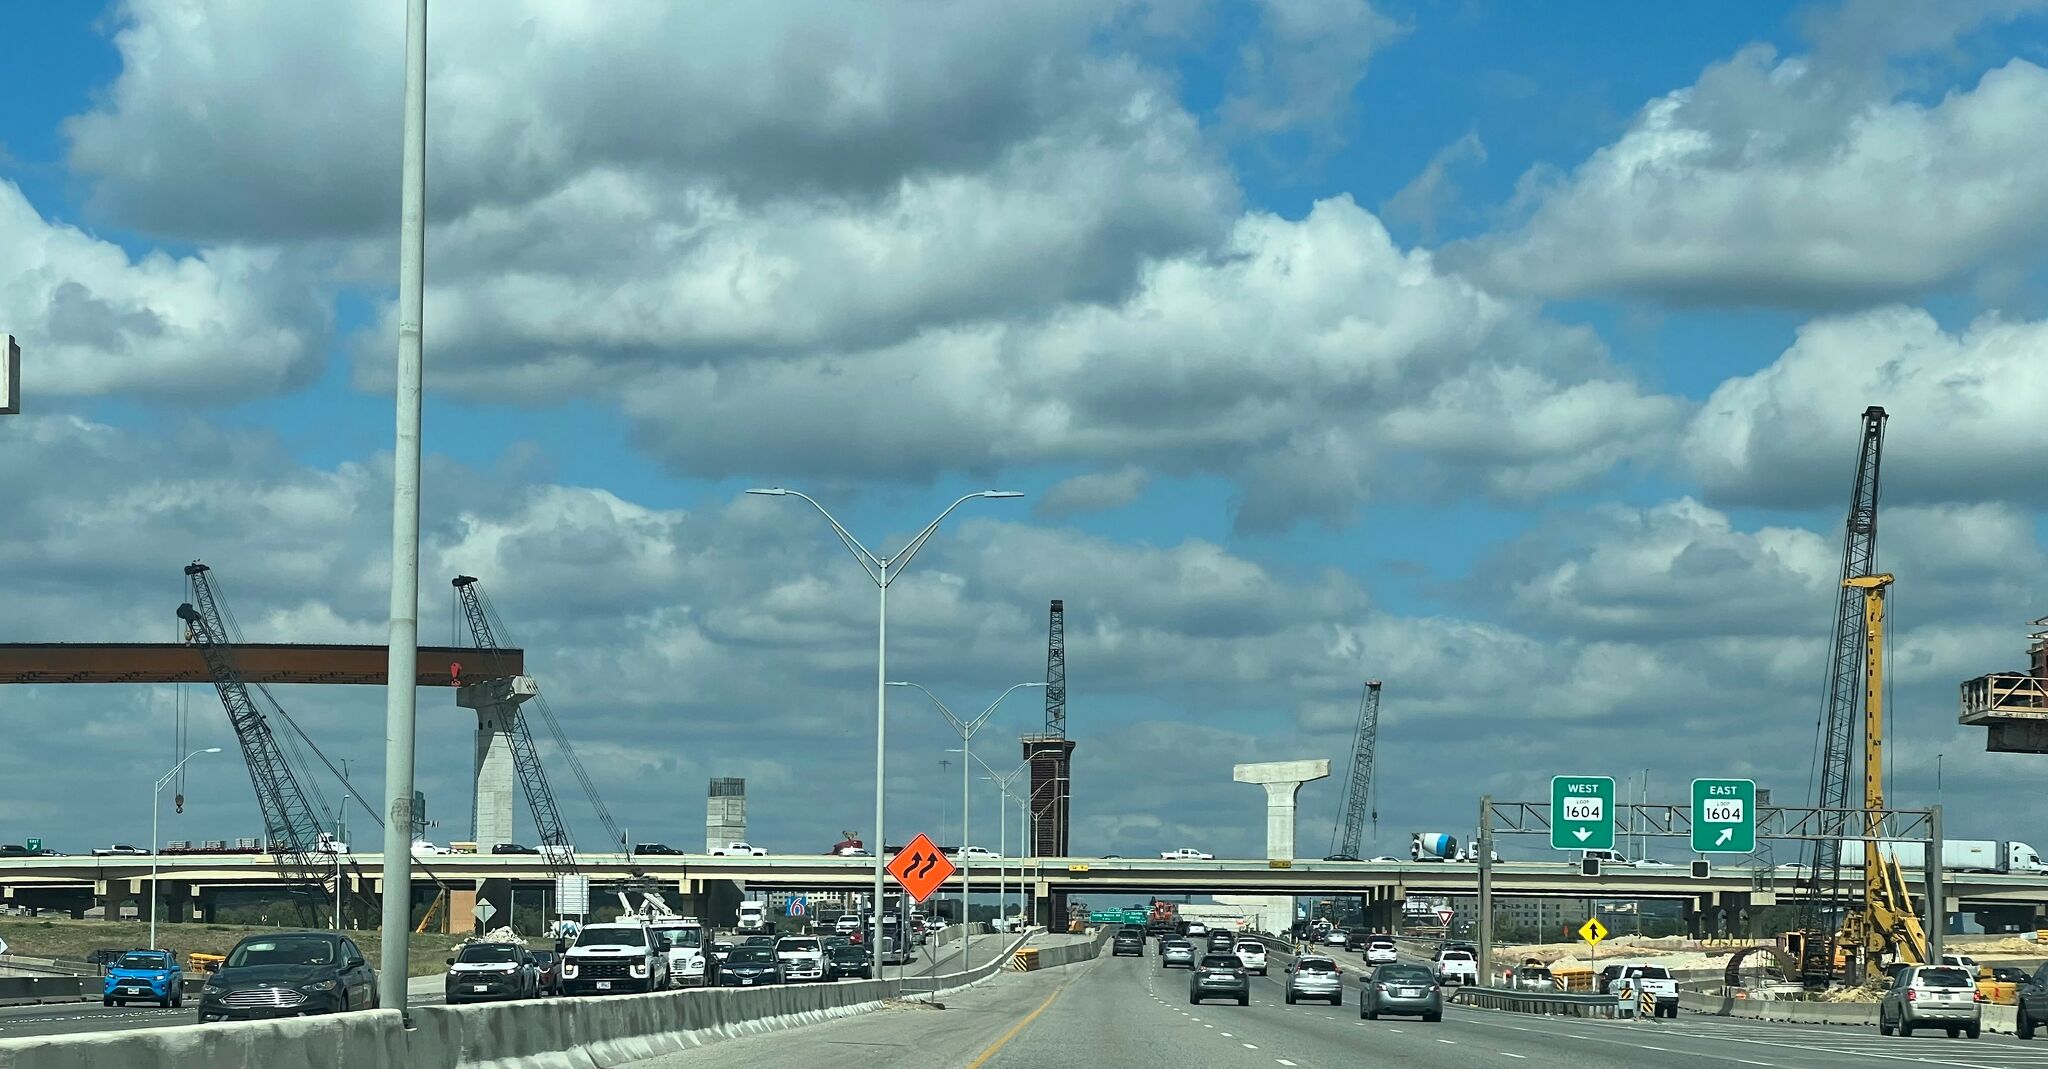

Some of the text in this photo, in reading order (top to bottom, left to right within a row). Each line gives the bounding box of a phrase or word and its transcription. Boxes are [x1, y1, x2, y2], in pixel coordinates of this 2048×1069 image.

[1568, 784, 1599, 793] WEST
[1709, 786, 1738, 795] EAST
[1566, 806, 1600, 818] 1604
[1706, 808, 1740, 820] 1604
[790, 897, 805, 916] 6
